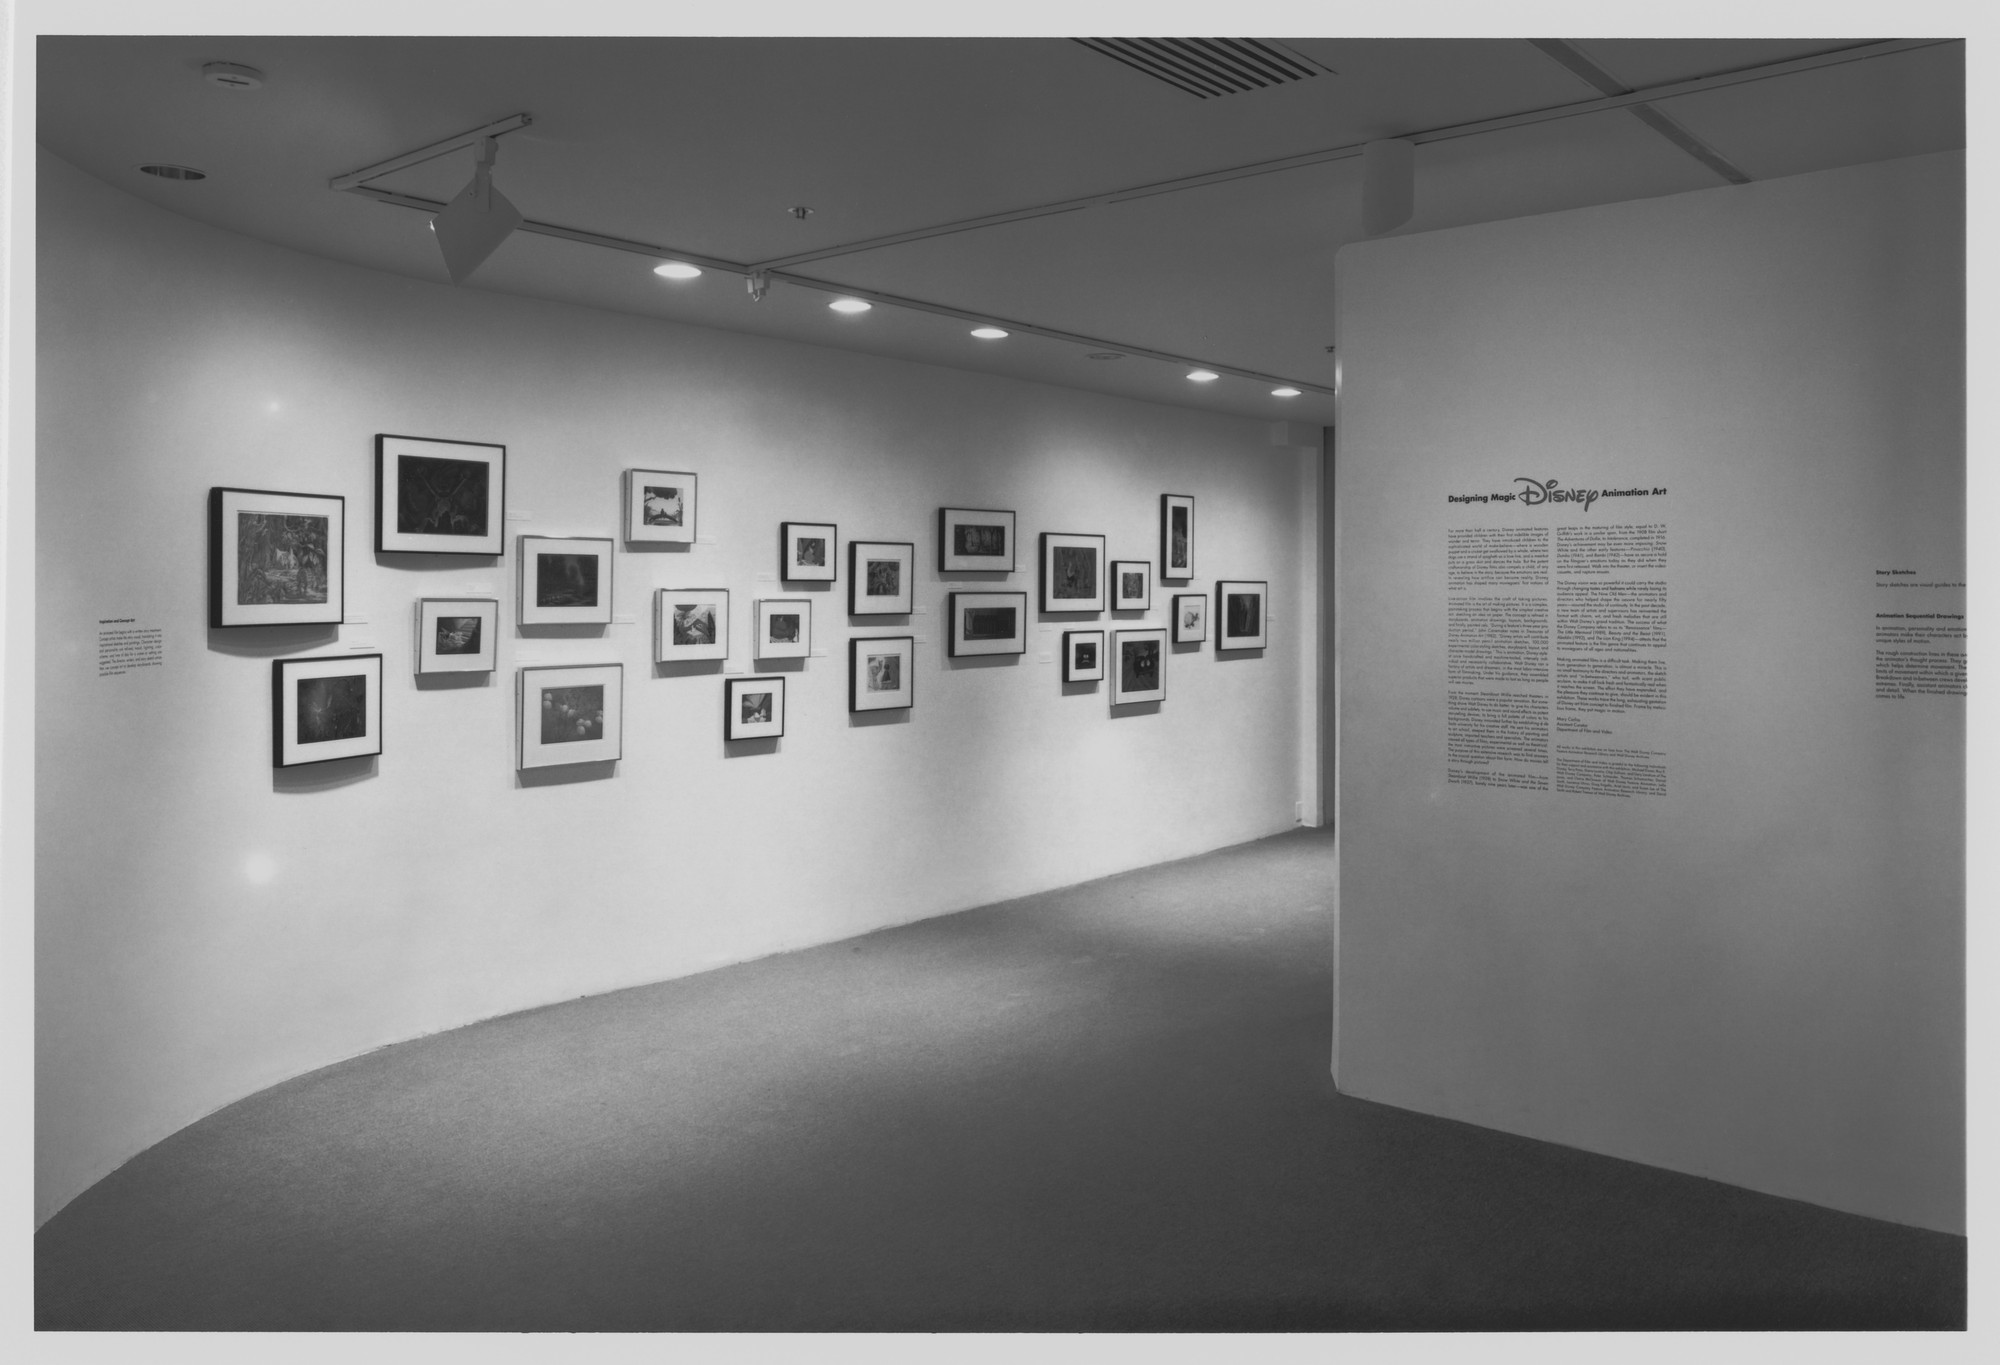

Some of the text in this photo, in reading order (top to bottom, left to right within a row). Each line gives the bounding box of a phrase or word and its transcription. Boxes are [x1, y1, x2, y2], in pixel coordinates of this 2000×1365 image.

[1447, 493, 1489, 504] Designing
[1490, 493, 1516, 503] Magic
[1601, 487, 1650, 497] Animation
[1651, 487, 1668, 496] Art
[1906, 613, 1935, 621] Sequential
[1936, 613, 1964, 621] Drawings
